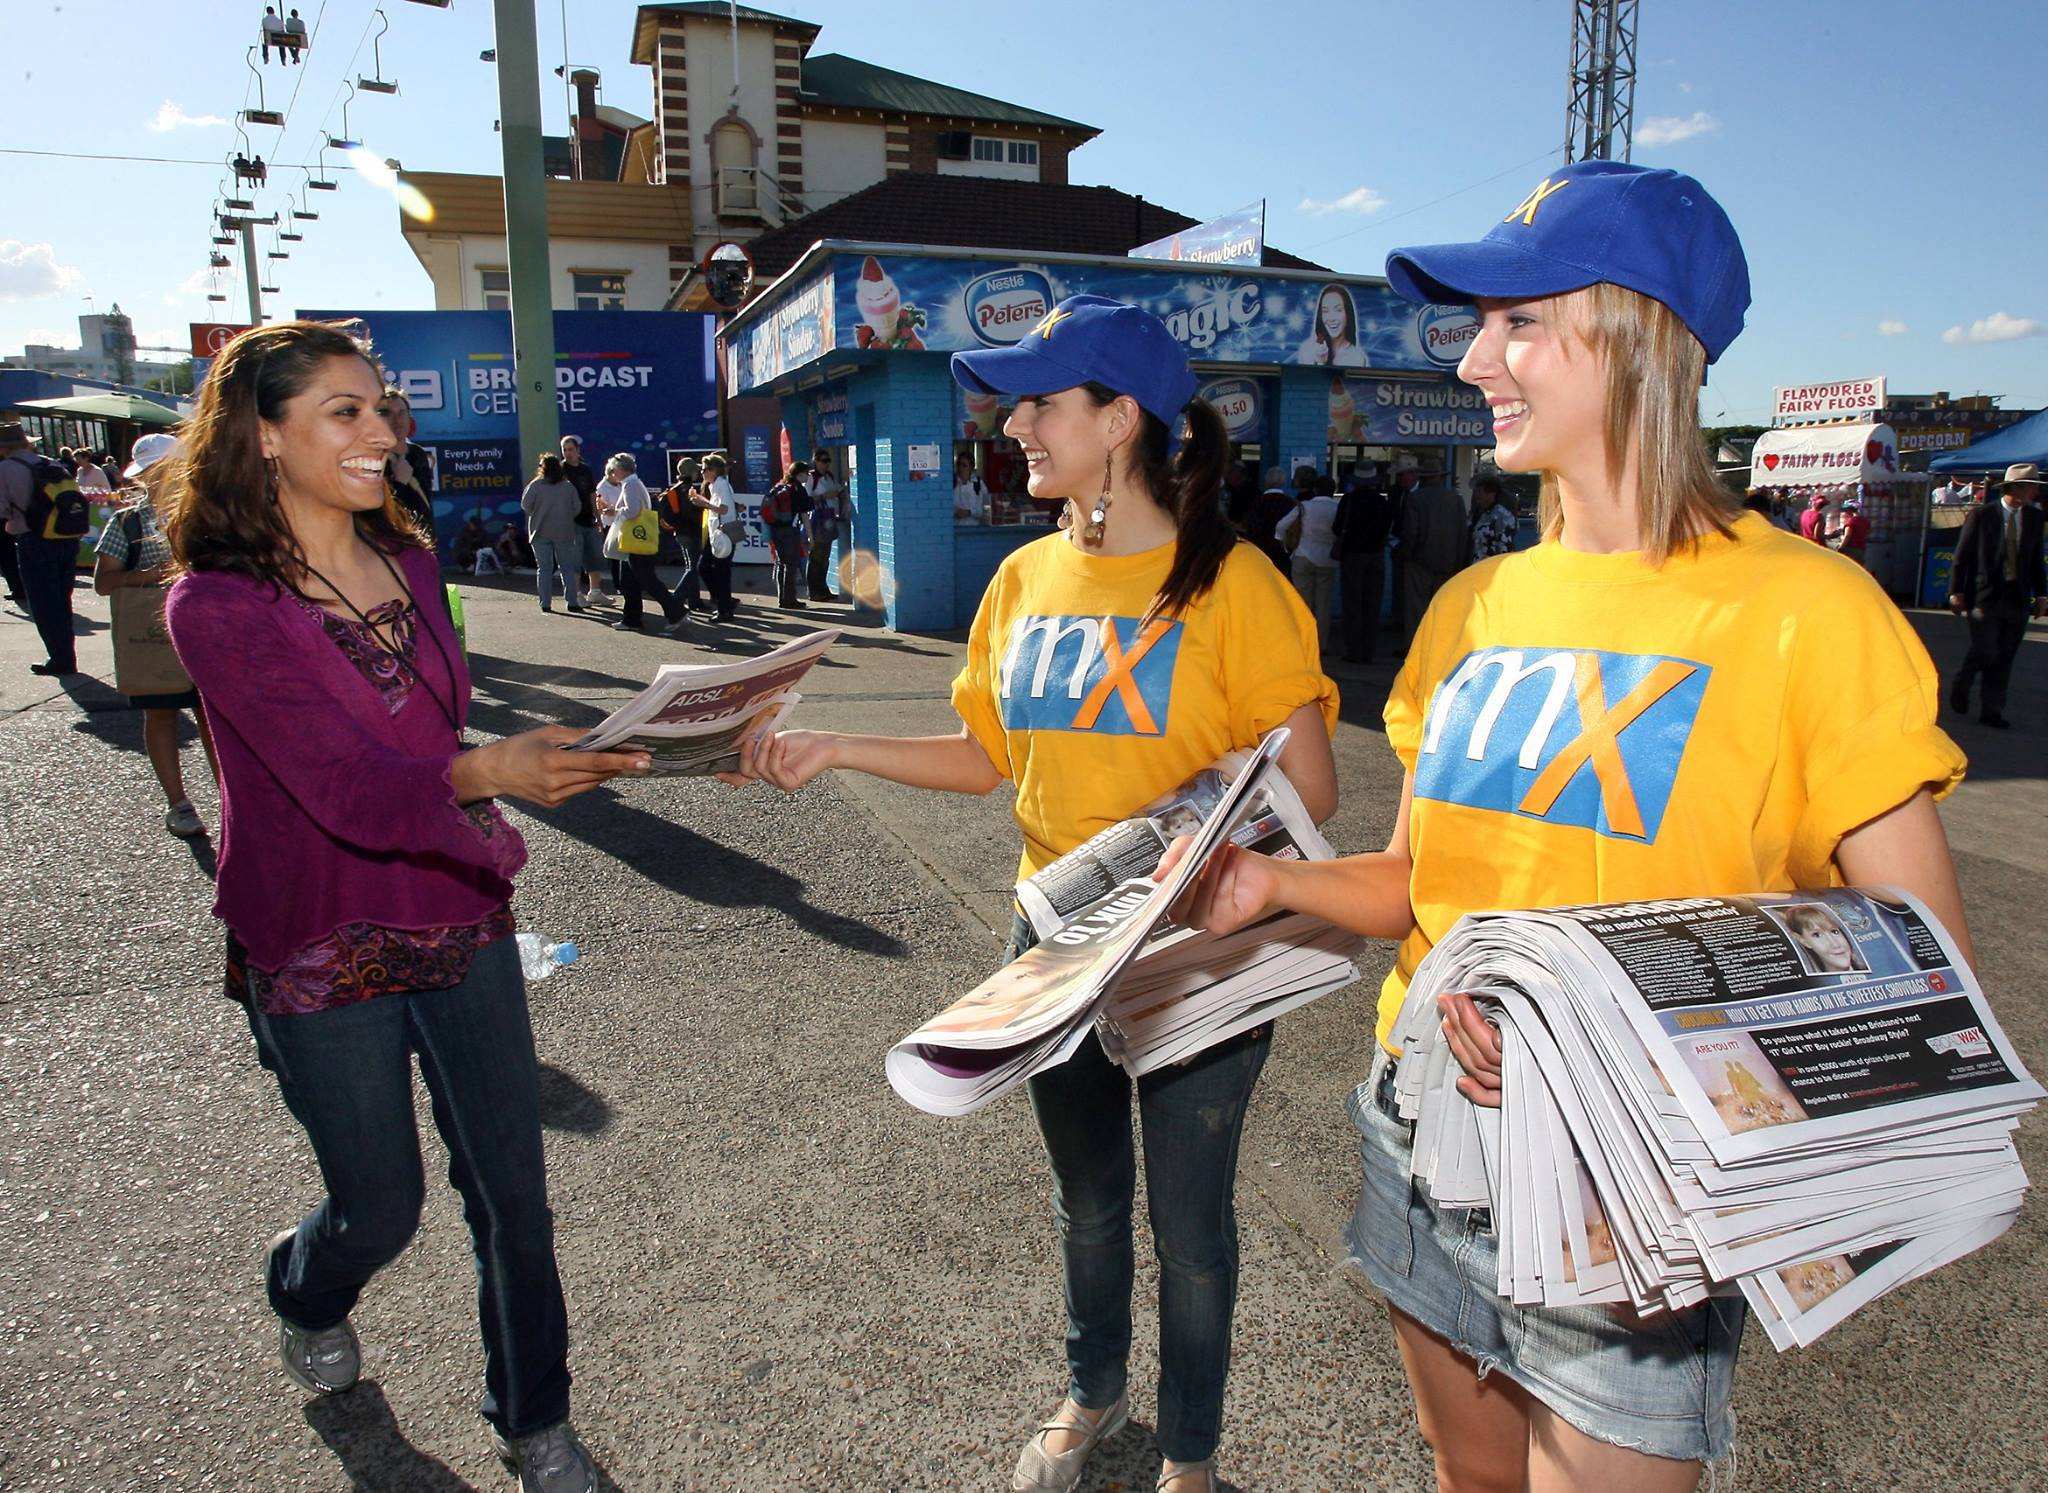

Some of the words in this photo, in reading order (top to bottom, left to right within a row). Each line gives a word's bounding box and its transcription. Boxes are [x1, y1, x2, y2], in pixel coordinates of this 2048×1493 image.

[1190, 236, 1256, 263] Strawberry
[977, 299, 1046, 328] Peters
[1165, 281, 1261, 349] agic
[1427, 324, 1477, 348] Peters
[468, 366, 653, 390] BRDCAST
[535, 381, 543, 392] 6
[471, 391, 586, 414] CERE
[1376, 383, 1488, 409] Strawber
[1783, 383, 1873, 401] FLAVOURED
[1217, 400, 1247, 417] 4.50
[1779, 399, 1823, 414] FAIRY
[1829, 395, 1876, 410] FLOSS
[1397, 412, 1485, 437] Sundae
[1901, 432, 1966, 449] POPCORN
[444, 449, 470, 460] Every
[473, 448, 503, 460] Family
[1781, 453, 1819, 469] FAIRY
[1822, 451, 1862, 468] FLOSS
[455, 462, 482, 472] Needs
[487, 462, 496, 471] A
[440, 473, 513, 489] Farmer
[1616, 916, 1646, 932] need
[1646, 915, 1657, 928] to
[1655, 910, 1681, 926] find
[1679, 909, 1700, 922] her
[1746, 1005, 1758, 1021] TO
[1757, 1003, 1772, 1020] GET
[1771, 1000, 1796, 1018] YOUR
[1832, 991, 1850, 1009] THE
[1848, 984, 1887, 1007] SWEETEST
[1760, 1037, 1772, 1046] Do
[1772, 1035, 1786, 1047] you
[1787, 1033, 1803, 1044] have
[1804, 1031, 1821, 1041] what
[1828, 1027, 1849, 1038] takes
[1857, 1023, 1868, 1032] be
[1868, 1016, 1904, 1030] Brisbane's
[1905, 1013, 1921, 1023] next
[1696, 1043, 1711, 1054] ARE
[1711, 1041, 1727, 1053] YOU
[1781, 1046, 1796, 1056] Girl
[1814, 1042, 1829, 1053] Boy
[1853, 1034, 1888, 1047] Broadway
[1805, 1064, 1819, 1073] over
[1839, 1059, 1857, 1068] worth
[1864, 1055, 1883, 1066] prizes
[1883, 1053, 1897, 1063] plus
[1897, 1051, 1911, 1061] your
[1791, 1076, 1815, 1088] chance
